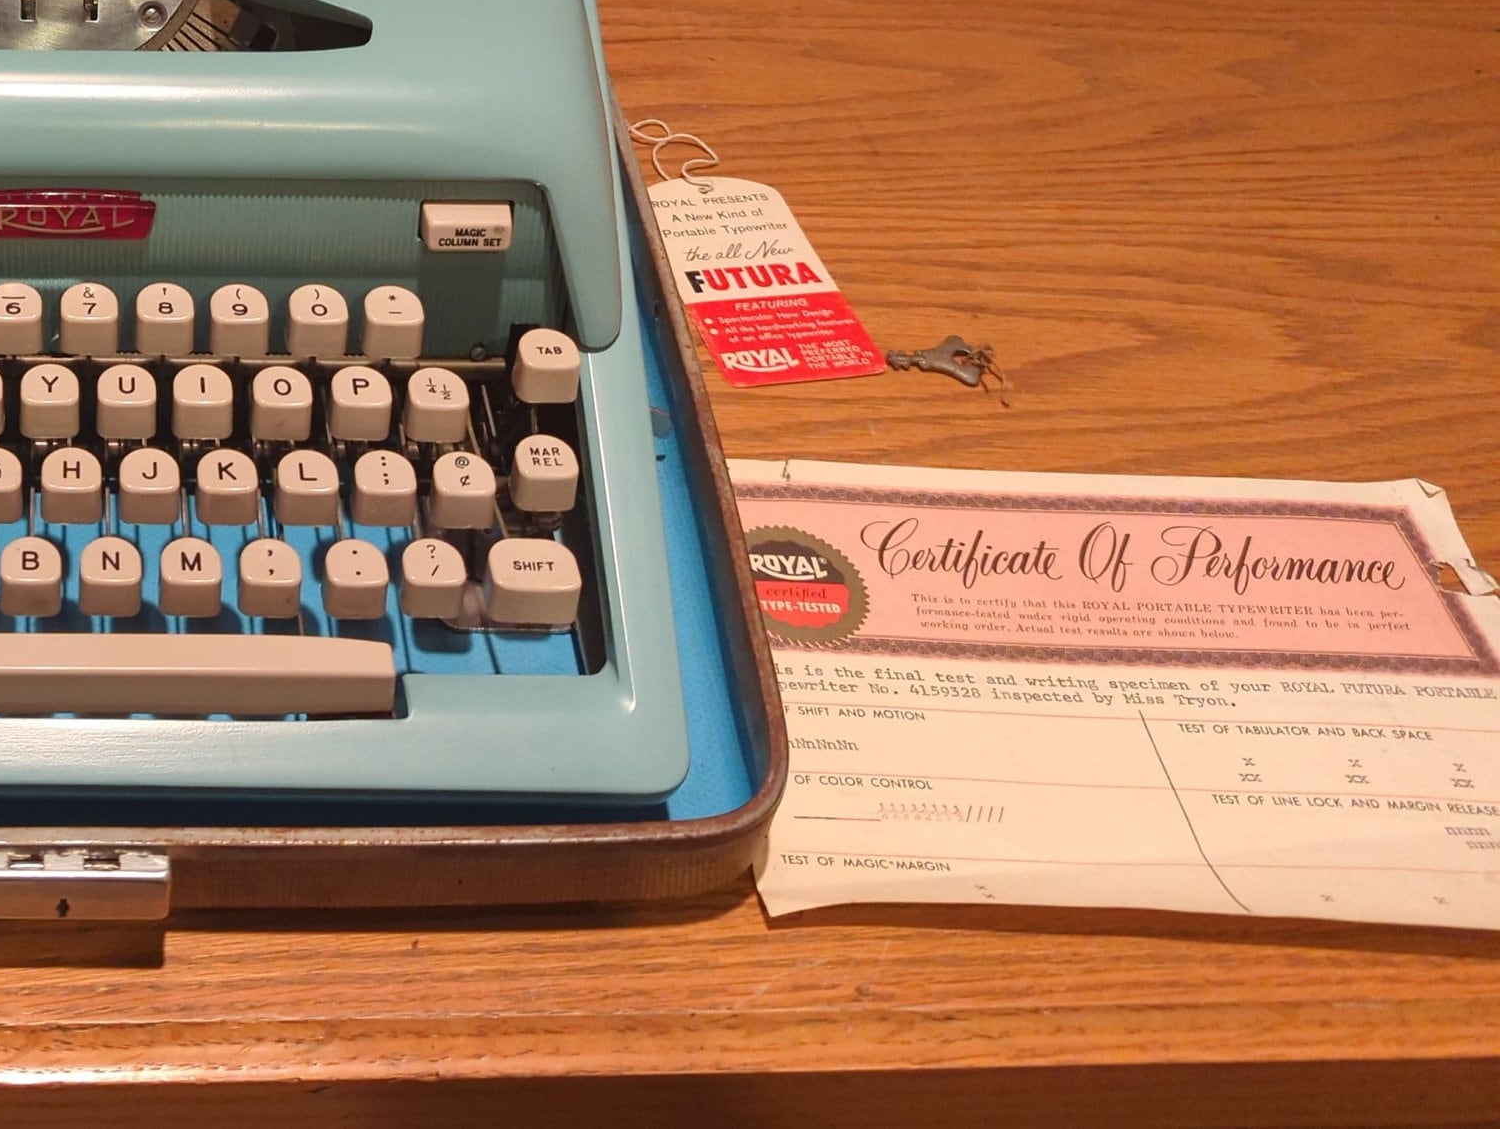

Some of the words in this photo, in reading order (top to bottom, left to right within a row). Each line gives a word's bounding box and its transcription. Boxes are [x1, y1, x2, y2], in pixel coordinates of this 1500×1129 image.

[652, 198, 696, 209] ROYAL
[703, 193, 769, 206] PRESENTS
[671, 214, 682, 223] A
[685, 211, 713, 221] New
[717, 208, 746, 220] Kind
[751, 207, 764, 217] of
[454, 228, 487, 239] MAGIC
[661, 226, 717, 238] Portable
[720, 222, 788, 236] Typewriter
[438, 238, 479, 248] COLUMN
[482, 237, 502, 247] SET
[683, 245, 711, 261] the
[715, 243, 742, 259] all
[744, 239, 795, 259] New
[684, 261, 822, 293] FUTURA
[5, 301, 21, 316] 6
[82, 302, 97, 316] 7
[157, 301, 174, 316] 8
[231, 302, 249, 317] 9
[310, 303, 328, 317] 0
[734, 298, 808, 312] FEATURING
[536, 345, 562, 356] TAB
[720, 347, 800, 372] ROYAL
[40, 376, 60, 394] Y
[118, 377, 136, 394] U
[199, 376, 206, 394] I
[273, 378, 292, 396] O
[351, 378, 370, 396] P
[529, 446, 560, 457] MAR
[62, 461, 81, 479] H
[532, 456, 563, 467] REL
[142, 462, 158, 480] J
[217, 462, 238, 480] K
[298, 463, 318, 482] L
[21, 551, 40, 571] B
[102, 552, 121, 571] N
[180, 552, 202, 571] M
[860, 517, 1063, 589] Certificate
[1079, 521, 1134, 593] Of
[1150, 525, 1406, 596] Performance
[512, 560, 555, 573] SHIFT
[748, 553, 828, 580] ROYAL
[765, 585, 828, 600] certified
[759, 599, 842, 614] TYPE-TESTED
[804, 664, 824, 677] is
[834, 667, 865, 679] the
[874, 667, 925, 682] final
[935, 671, 976, 684] test
[986, 674, 1017, 686] and
[1025, 676, 1099, 691] writing
[1108, 678, 1190, 692] specimen
[1200, 680, 1218, 692] of
[1230, 682, 1271, 694] your
[1279, 682, 1335, 694] ROYAL
[1341, 682, 1406, 696] FUTURA
[1413, 685, 1498, 699] PORTABLE
[868, 683, 899, 695] No.
[909, 684, 982, 699] 4159328
[992, 687, 1084, 704] inspected
[1092, 691, 1113, 705] by
[1122, 692, 1165, 705] Miss
[1174, 694, 1236, 708] Tryon.
[797, 706, 830, 717] SHIFT
[838, 708, 866, 718] AND
[873, 709, 926, 721] MOTION
[1177, 723, 1206, 734] TEST
[1212, 725, 1230, 734] OF
[1236, 725, 1311, 737] TABULATOR
[1317, 726, 1346, 737] AND
[1352, 727, 1386, 739] BACK
[1392, 729, 1434, 741] SPACE
[794, 774, 812, 785] OF
[818, 775, 864, 788] COLOR
[871, 777, 934, 791] CONTROL
[1211, 794, 1241, 805] TEST
[1247, 795, 1265, 805] OF
[1272, 795, 1301, 806] LINE
[1306, 796, 1344, 808] LOCK
[1350, 798, 1380, 809] AND
[1387, 800, 1442, 812] MARGIN
[1446, 802, 1500, 816] RELEASE
[780, 854, 809, 865] TEST
[817, 856, 836, 867] OF
[843, 858, 888, 870] MAGIC
[896, 860, 952, 872] MARGIN
